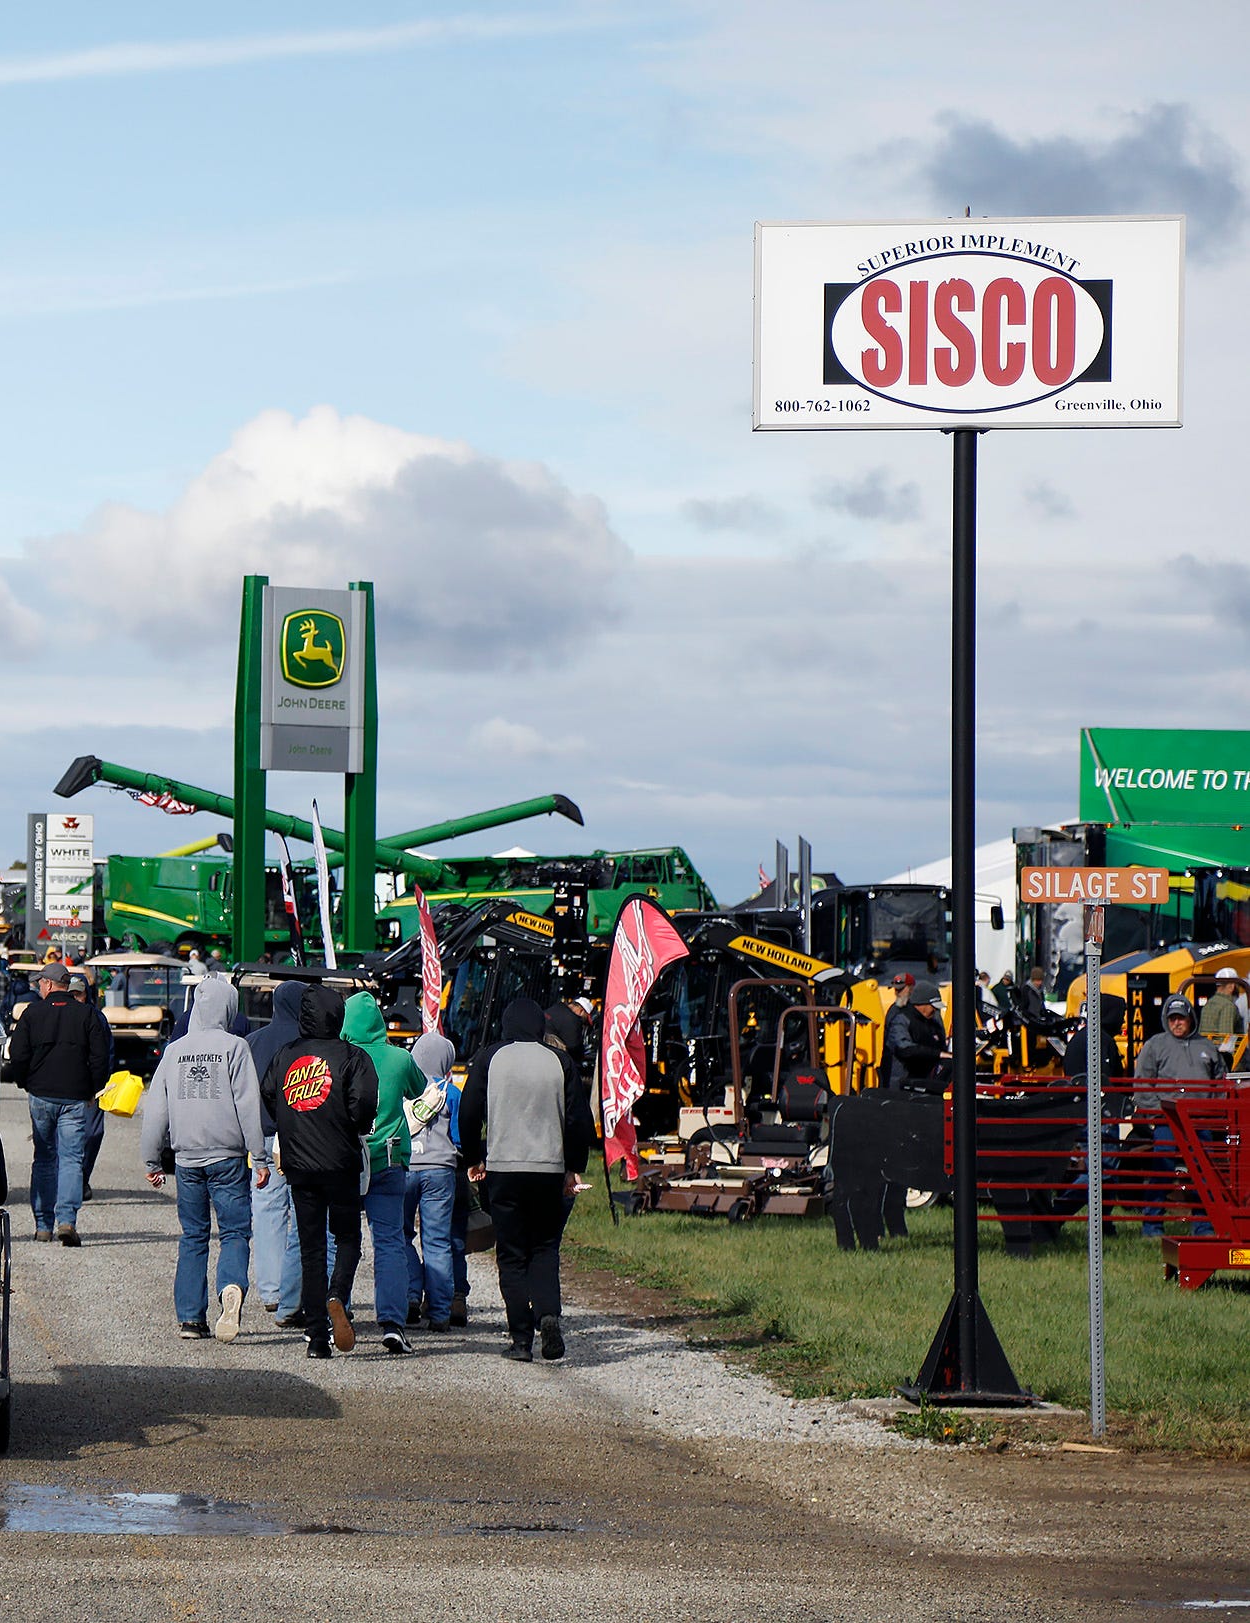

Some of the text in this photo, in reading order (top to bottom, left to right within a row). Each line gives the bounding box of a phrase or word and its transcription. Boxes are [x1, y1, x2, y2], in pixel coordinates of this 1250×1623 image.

[856, 234, 1081, 277] SUPERIOR IMPLEMENT
[860, 276, 1077, 388] SISCO
[774, 398, 871, 413] 800-762-1062
[1054, 399, 1162, 413] Greenville, Ohio
[277, 696, 346, 711] JOHN DEERE
[1094, 767, 1198, 790] WELCOME
[1202, 769, 1228, 790] TO
[50, 848, 90, 857] WHITE
[1027, 871, 1162, 899] SILAGE ST
[742, 939, 813, 972] NEW HOLLAND
[196, 1053, 223, 1063] ROCKETS
[282, 1059, 327, 1091] SANTA
[287, 1078, 325, 1106] CRUZ
